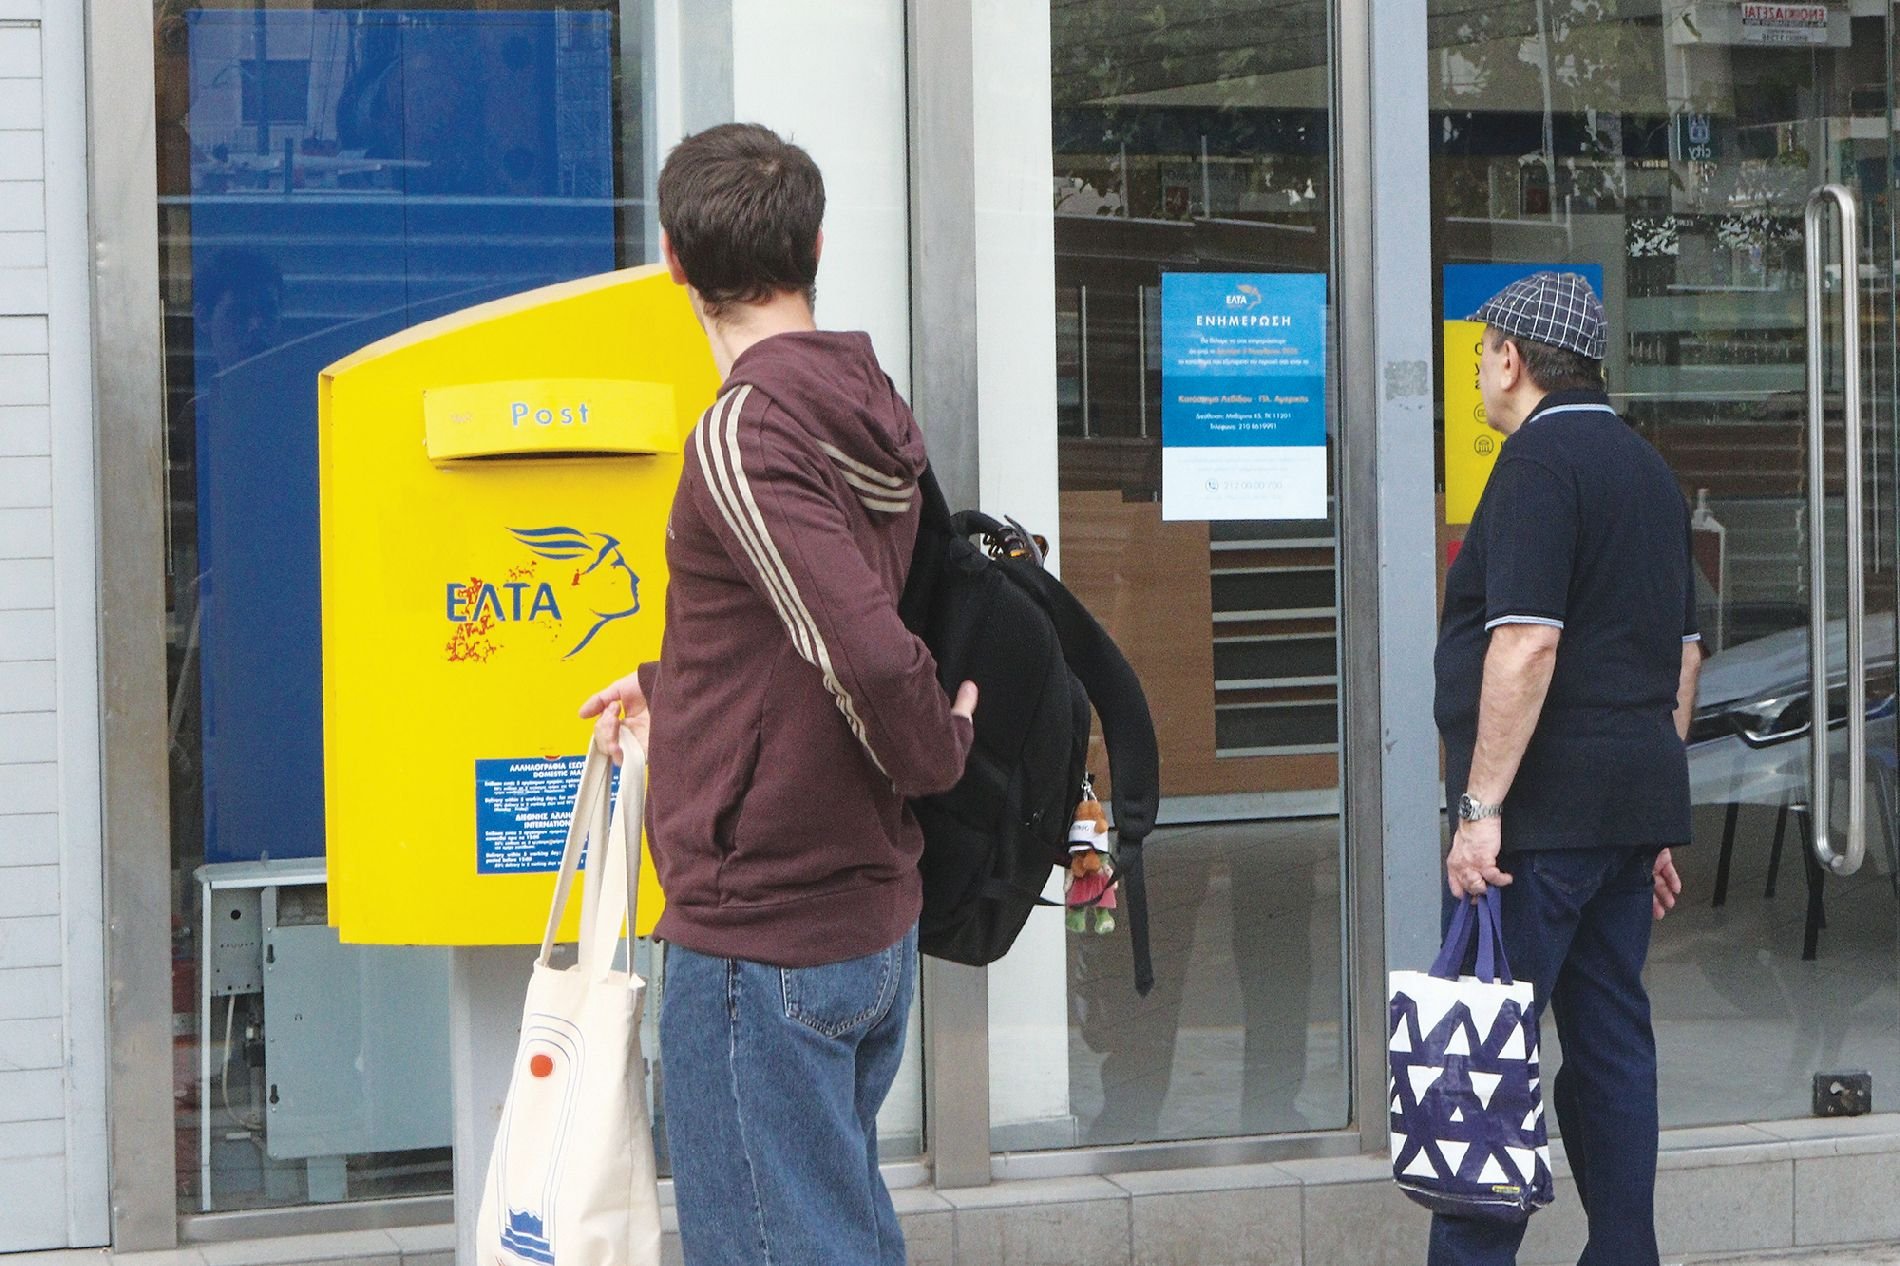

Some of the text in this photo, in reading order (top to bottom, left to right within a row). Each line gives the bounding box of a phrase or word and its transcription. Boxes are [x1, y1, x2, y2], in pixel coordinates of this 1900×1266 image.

[1226, 295, 1247, 304] ΕΛΤΑ
[1196, 315, 1292, 327] ΕΝΗΜΕΡΩΣΗ
[511, 402, 589, 427] Post
[446, 582, 563, 622] ΕΛΤΑ
[510, 763, 566, 772] ΑΛΛΗΛΟΓΡΑΦΙΑ
[533, 770, 568, 778] DOMESTIC
[524, 820, 572, 828] INTERNATION
